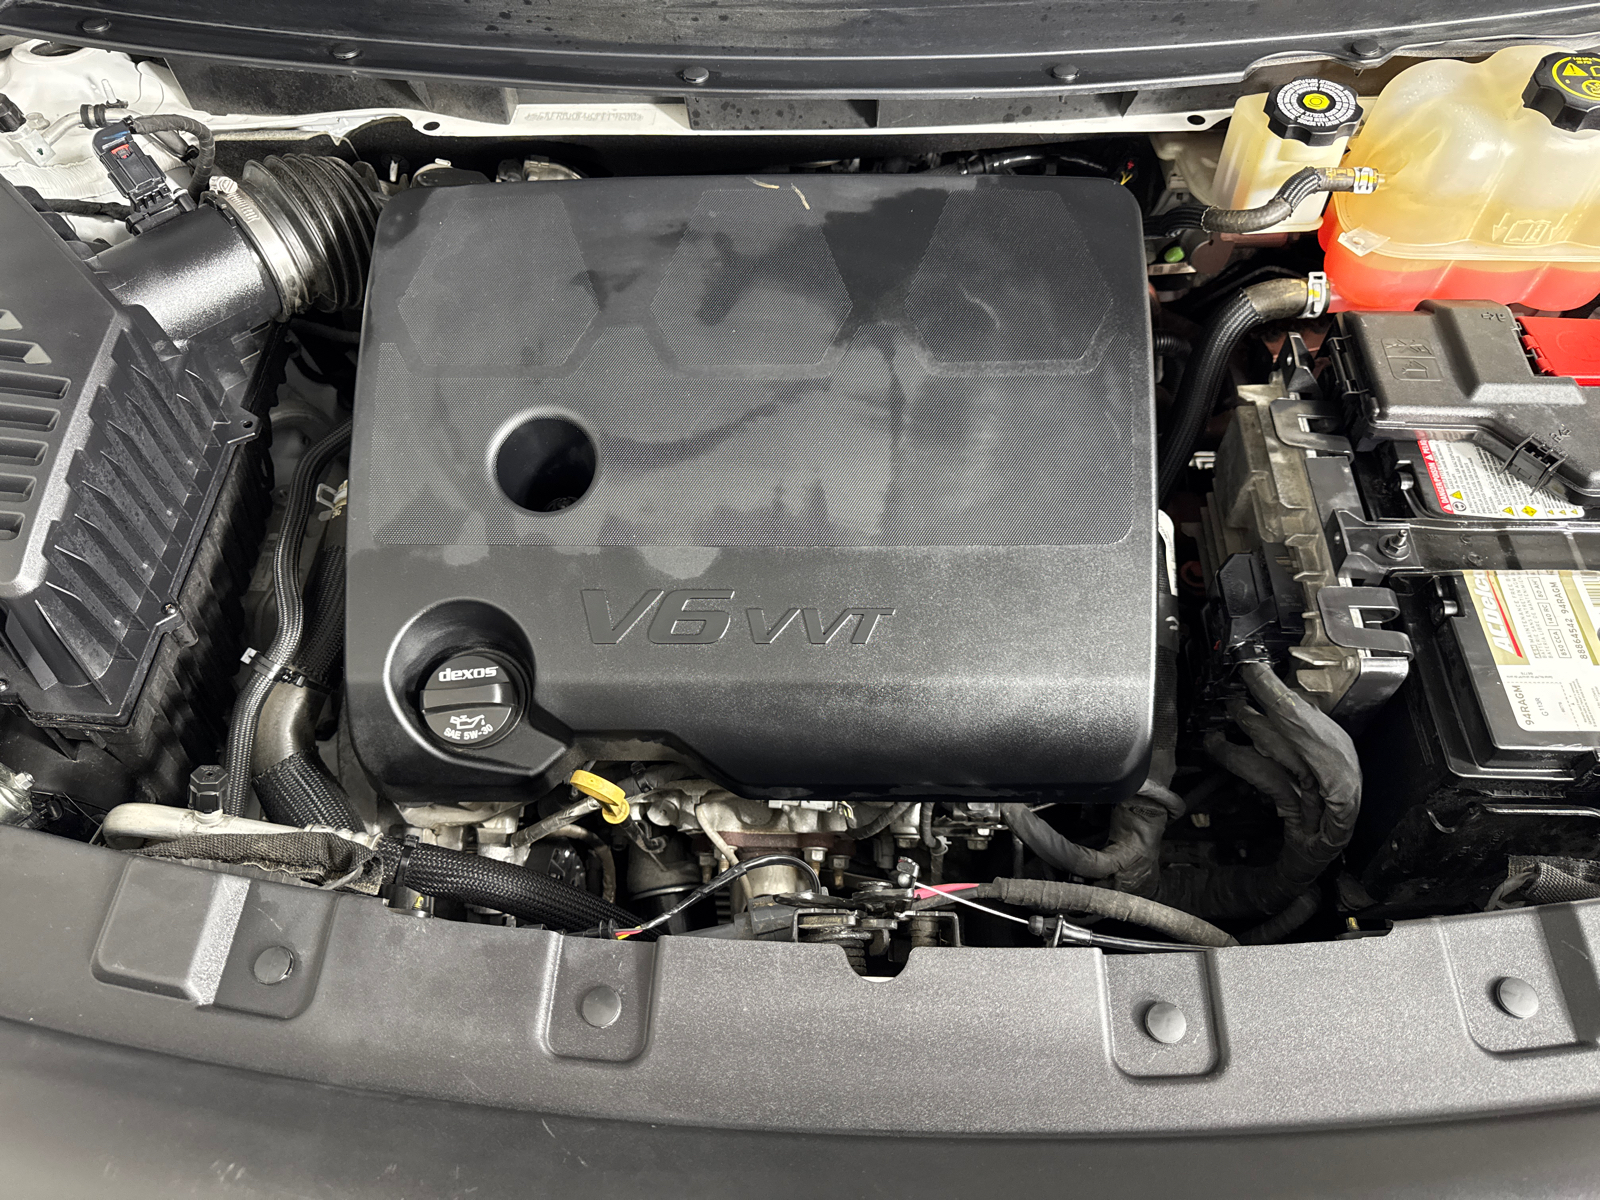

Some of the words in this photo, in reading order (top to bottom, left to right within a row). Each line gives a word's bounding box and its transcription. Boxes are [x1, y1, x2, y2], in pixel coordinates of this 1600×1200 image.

[1548, 581, 1569, 614] 94RAGM
[581, 588, 735, 645] V6
[745, 606, 896, 645] VVT
[1563, 618, 1588, 659] 88864542
[438, 666, 498, 682] dexos
[1511, 684, 1535, 725] 94RAGM
[443, 727, 461, 740] SAE
[463, 723, 493, 740] 5W-30
